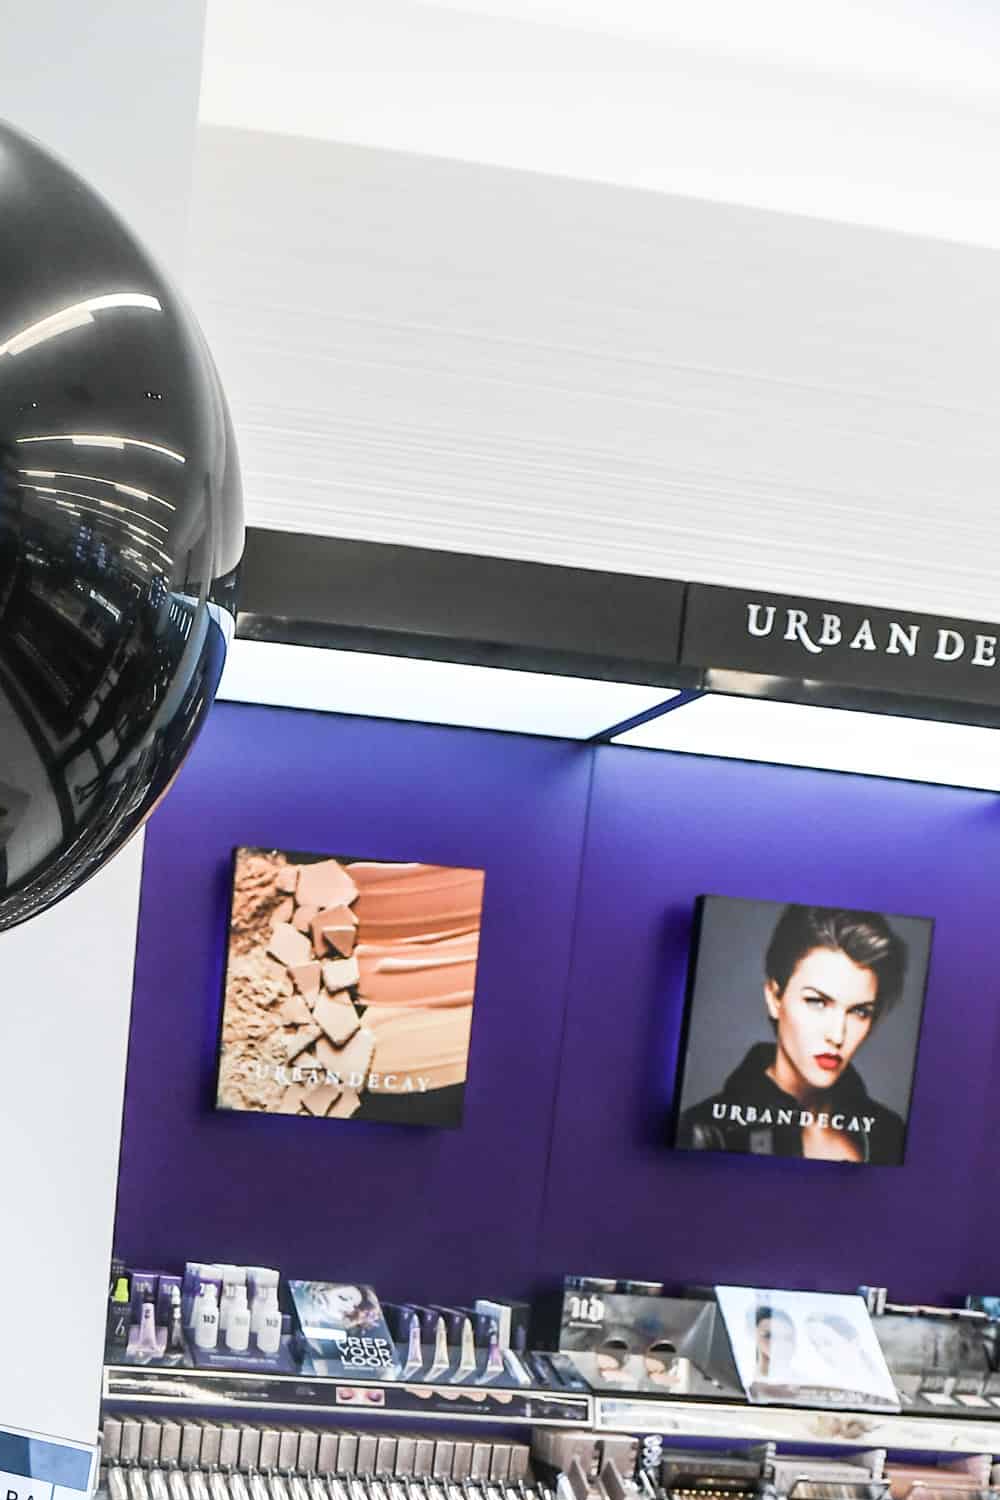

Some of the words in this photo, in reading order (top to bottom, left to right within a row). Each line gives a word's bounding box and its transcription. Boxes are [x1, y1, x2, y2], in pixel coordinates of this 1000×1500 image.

[747, 603, 920, 657] URBAN
[349, 1071, 432, 1093] DECAY
[711, 1102, 794, 1127] URBAN
[799, 1110, 876, 1134] DECAY
[339, 1346, 392, 1357] YOUR
[341, 1356, 395, 1368] LOOK
